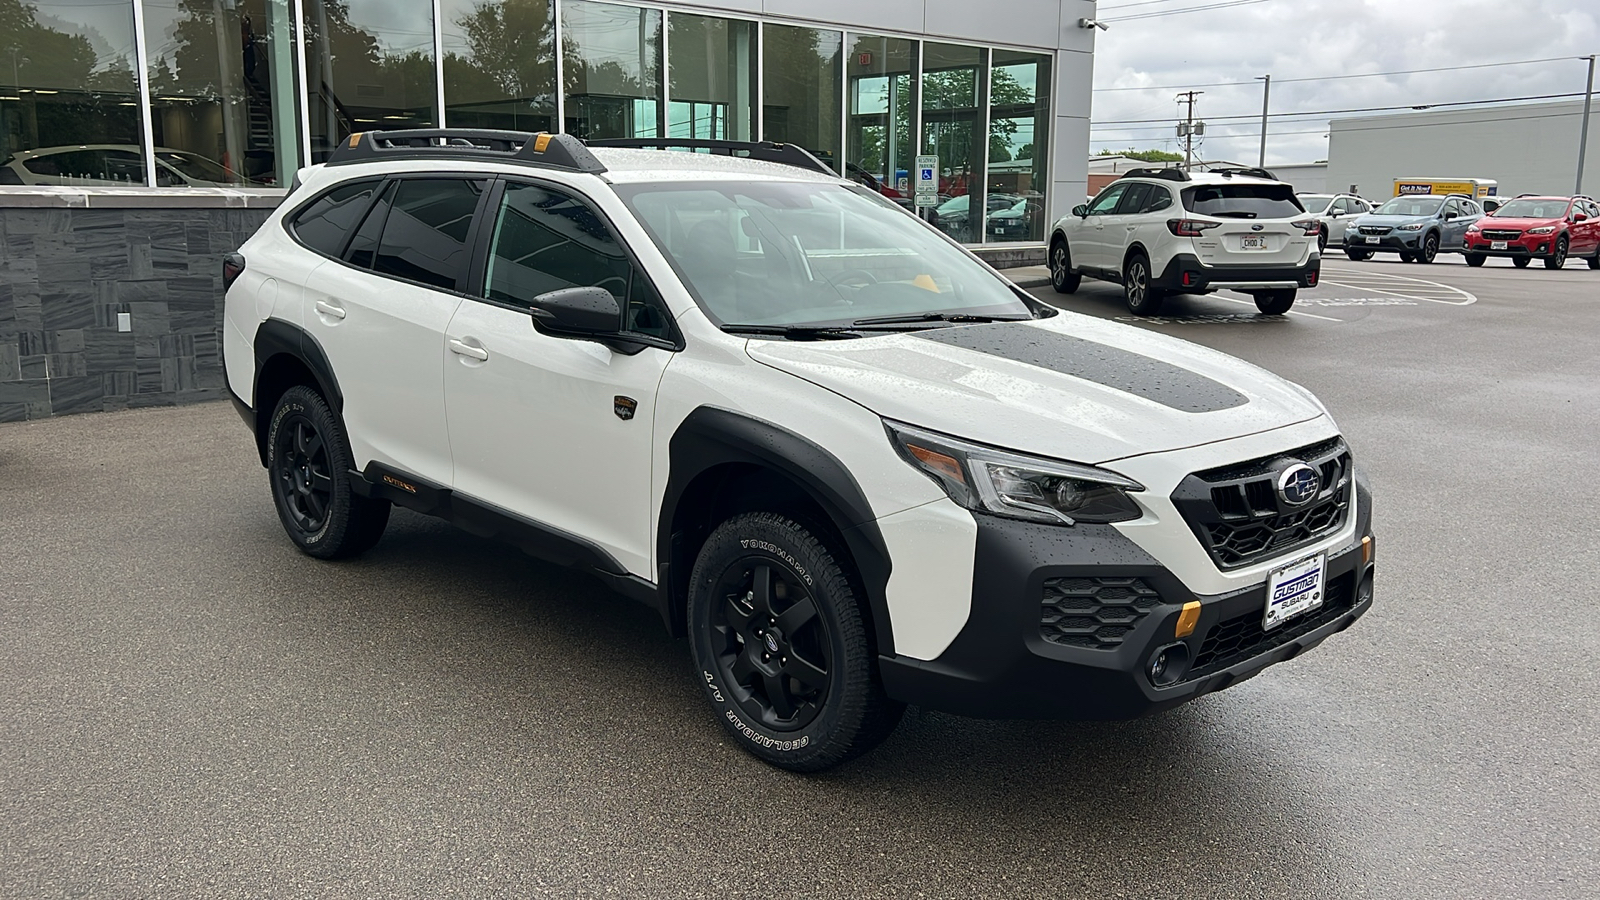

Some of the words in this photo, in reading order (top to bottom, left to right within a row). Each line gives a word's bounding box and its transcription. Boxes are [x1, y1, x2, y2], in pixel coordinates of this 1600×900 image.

[741, 539, 813, 586] YOKOHAMA
[1281, 592, 1310, 610] SUBARU
[703, 670, 725, 702] A/T
[726, 709, 809, 751] GEOLANDAR
